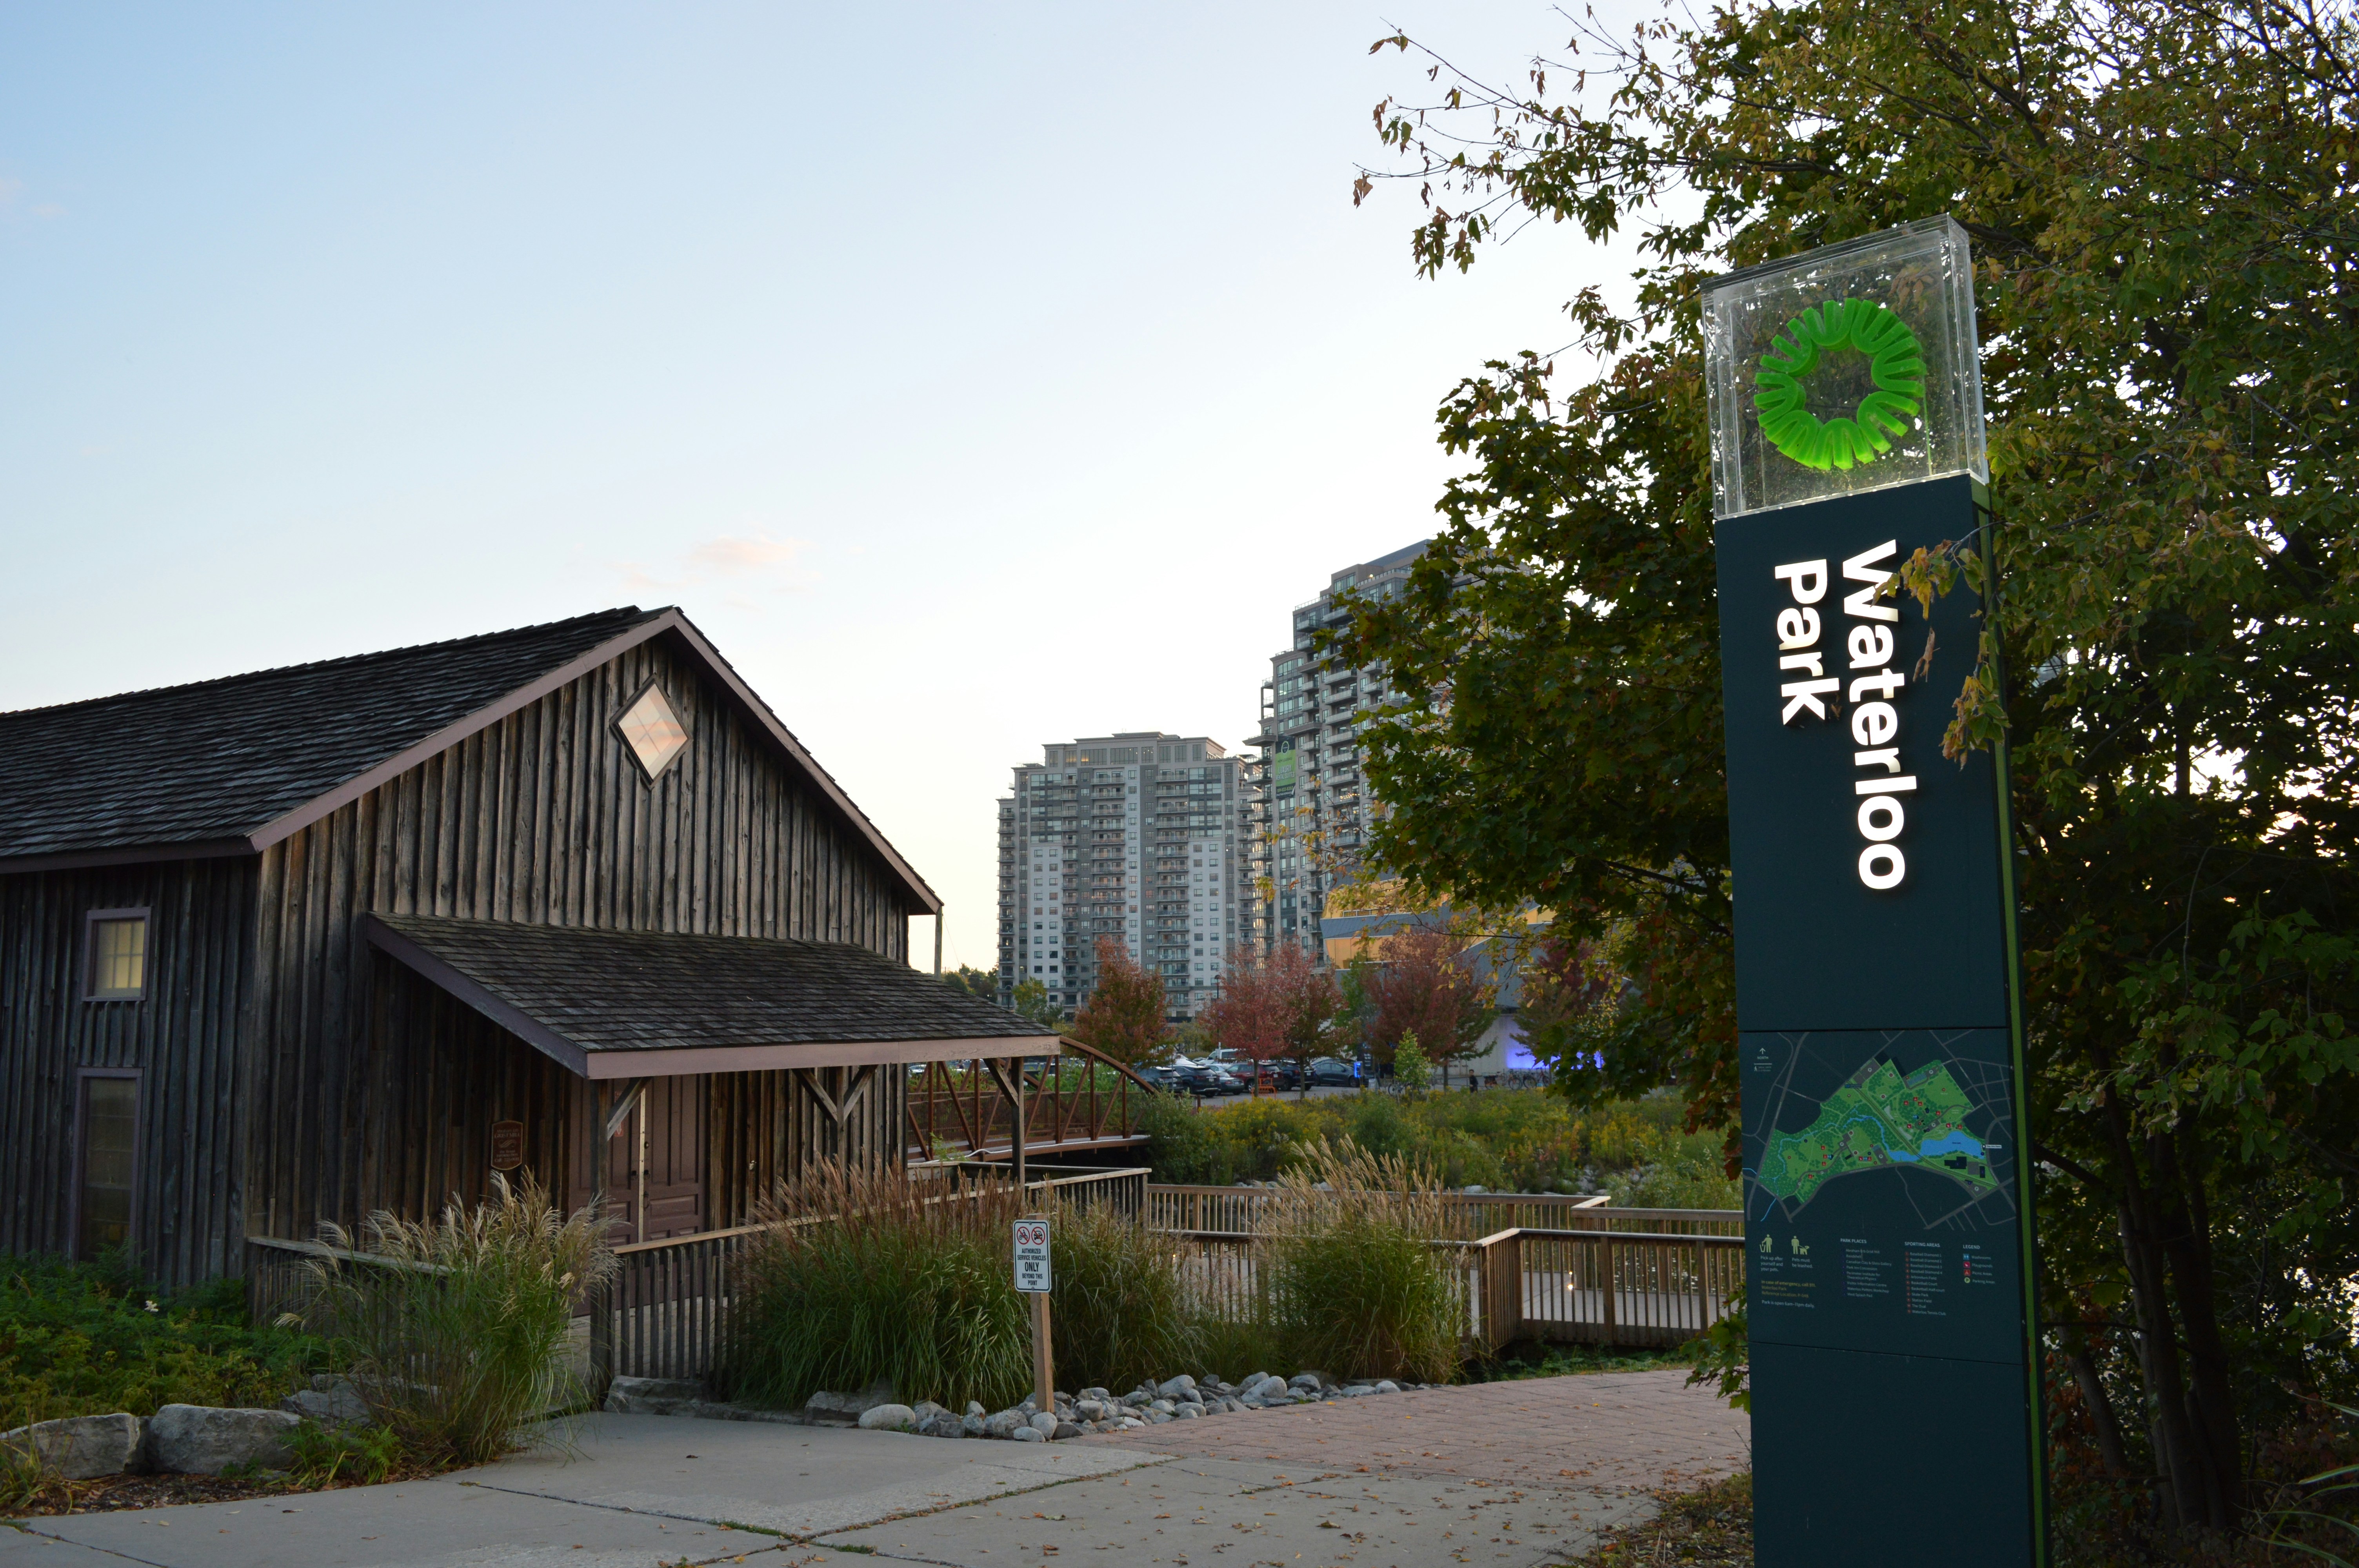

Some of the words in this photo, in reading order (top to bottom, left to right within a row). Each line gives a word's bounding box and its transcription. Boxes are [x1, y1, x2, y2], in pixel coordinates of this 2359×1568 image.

[1775, 559, 1839, 725] Park
[1843, 539, 1917, 889] Waterloo
[1278, 765, 1292, 774] LUXURY
[1025, 1262, 1039, 1272] ONLY
